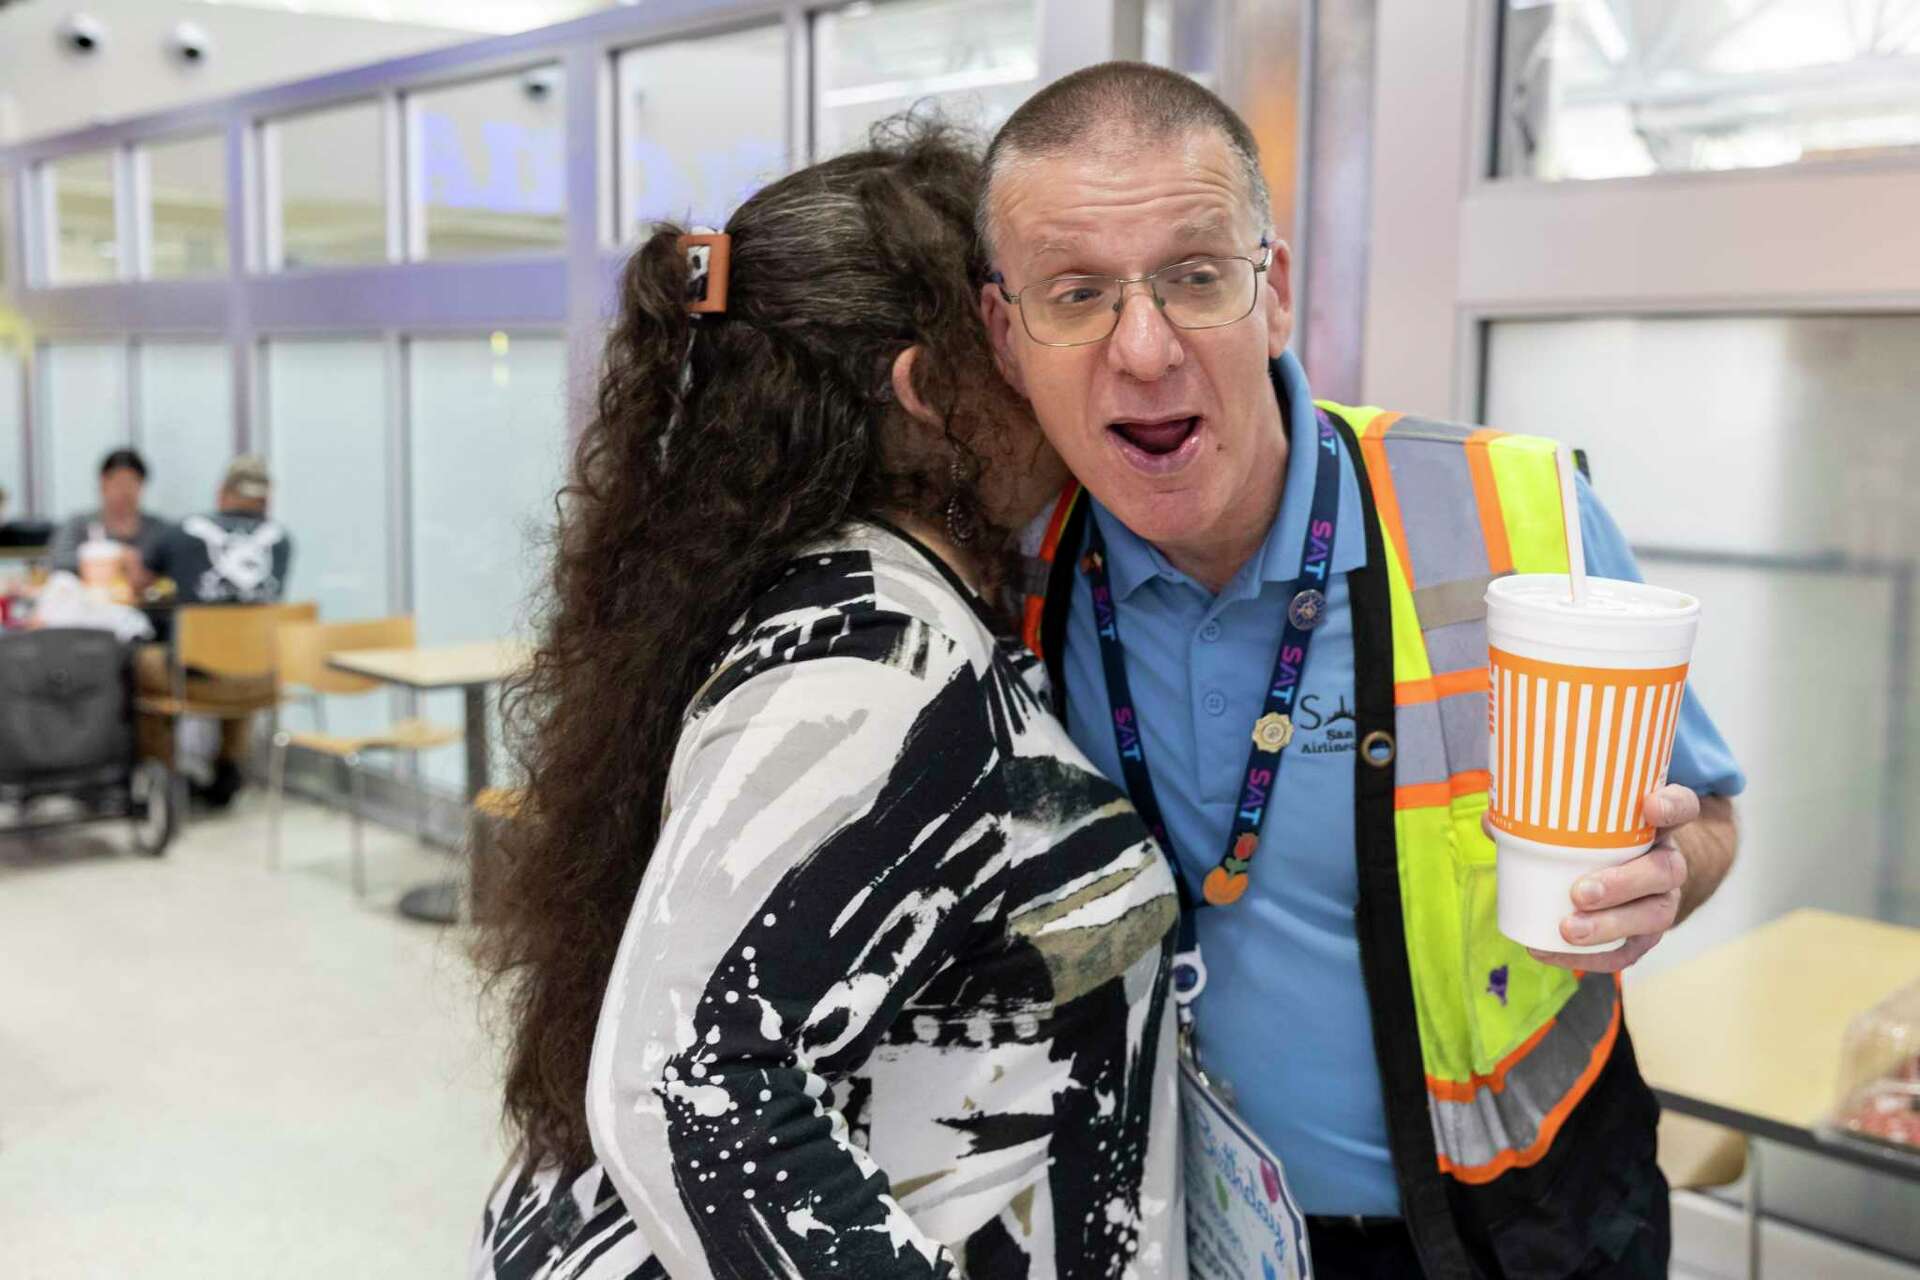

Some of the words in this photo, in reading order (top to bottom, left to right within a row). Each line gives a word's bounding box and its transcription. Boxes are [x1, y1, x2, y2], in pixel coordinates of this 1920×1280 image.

[1305, 519, 1333, 580] SAT
[1093, 586, 1116, 641] SAT
[1272, 645, 1304, 704] SAT
[1114, 706, 1142, 762] SAT
[1239, 768, 1272, 825] SAT
